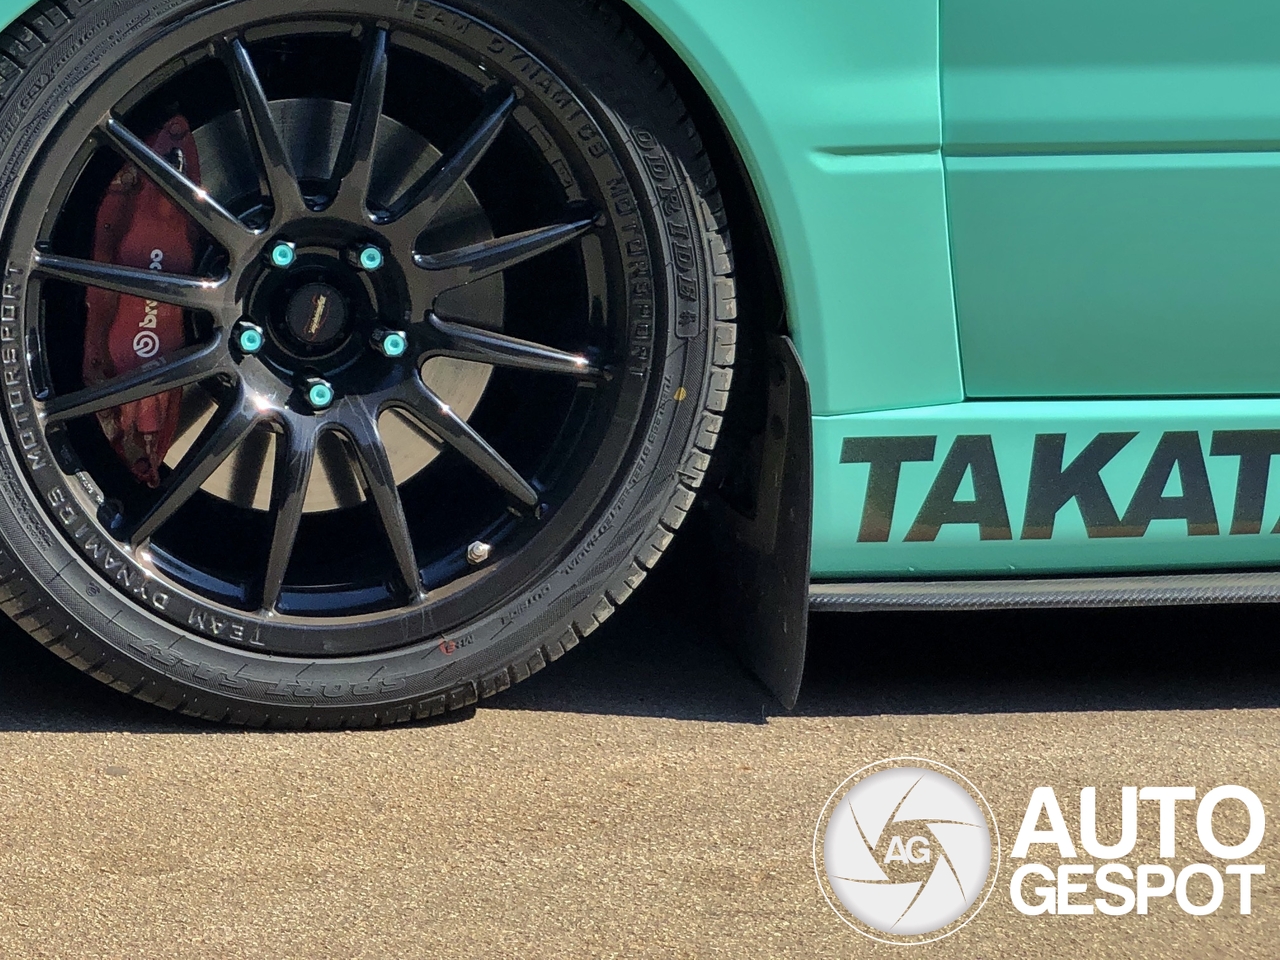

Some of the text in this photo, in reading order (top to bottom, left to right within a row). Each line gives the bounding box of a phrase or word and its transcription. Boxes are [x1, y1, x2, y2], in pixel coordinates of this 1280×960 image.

[2, 265, 48, 471] MOTORSPORT
[838, 429, 1280, 543] TAKAT
[46, 485, 172, 611] DYNAMICS
[187, 606, 266, 647] TEAM
